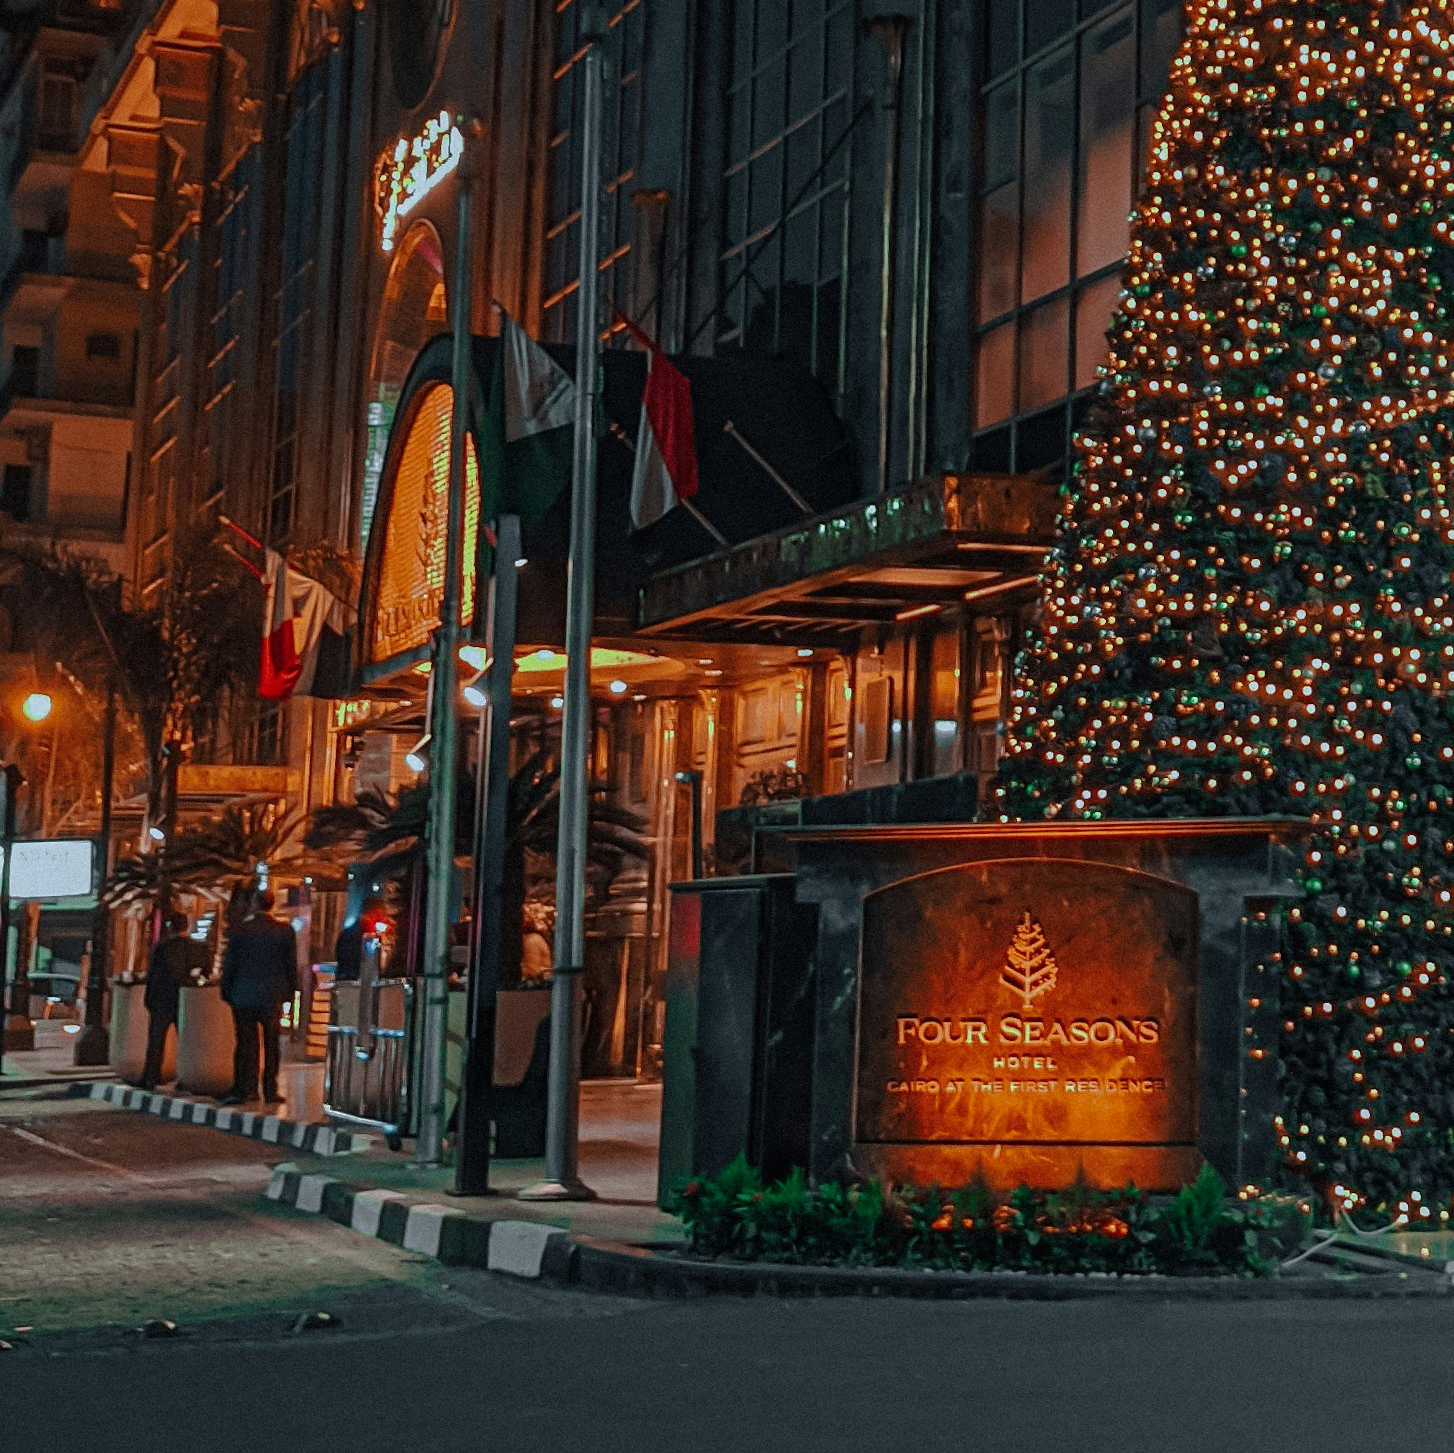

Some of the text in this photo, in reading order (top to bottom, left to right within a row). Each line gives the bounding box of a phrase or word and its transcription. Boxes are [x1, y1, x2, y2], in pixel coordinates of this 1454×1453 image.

[896, 1015, 1160, 1045] FOUR SEASONS
[993, 1054, 1058, 1070] HOTEL
[887, 1078, 1166, 1094] CAIRO AT THE FIRST RESDENCE
